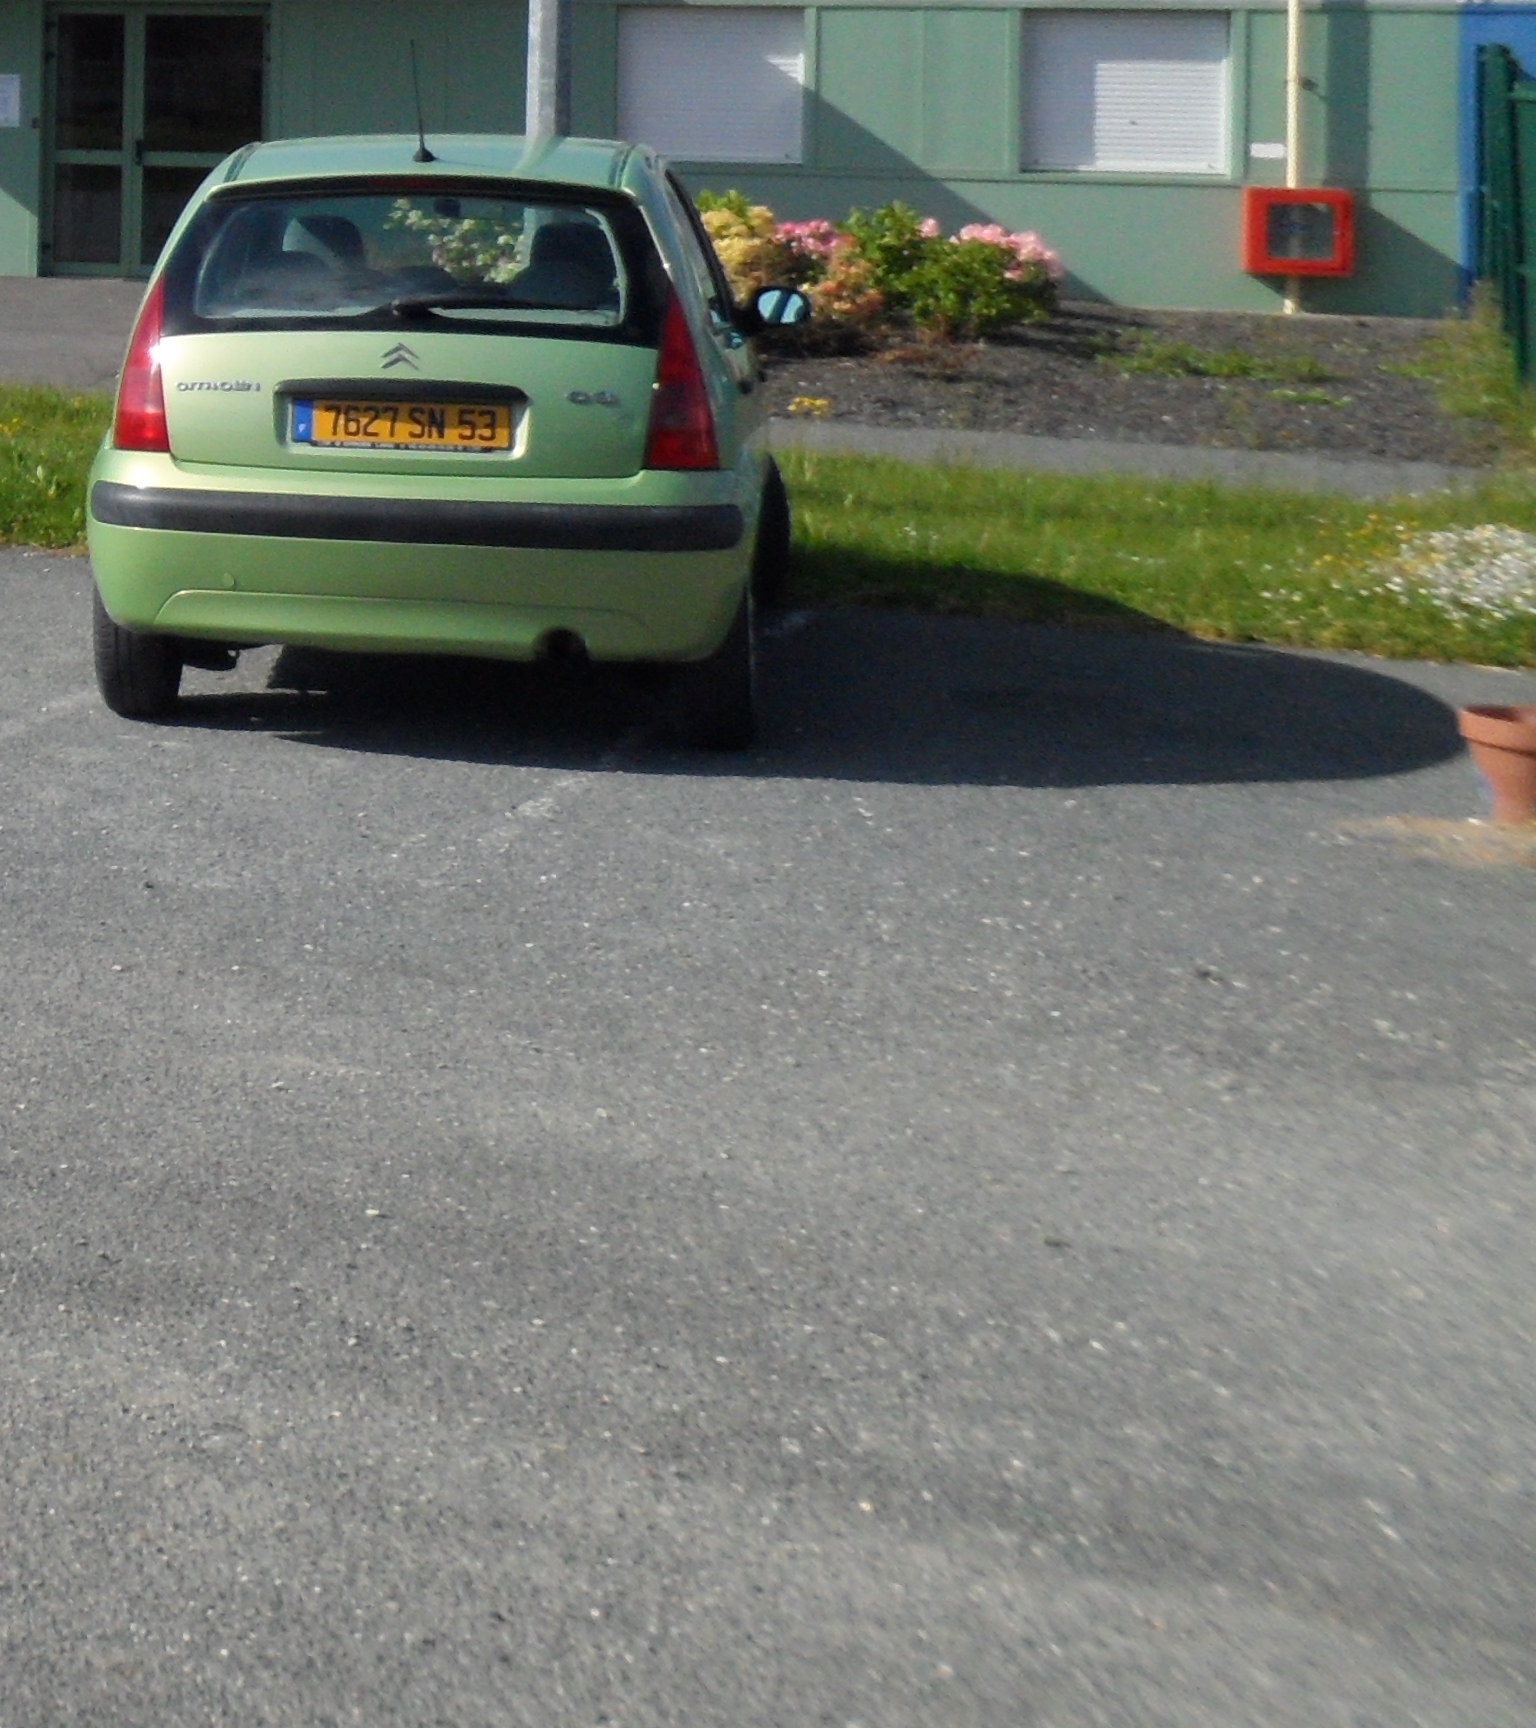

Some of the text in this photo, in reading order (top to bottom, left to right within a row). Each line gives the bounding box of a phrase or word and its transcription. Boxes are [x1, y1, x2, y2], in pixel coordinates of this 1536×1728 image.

[325, 404, 497, 442] 7627 SN 53
